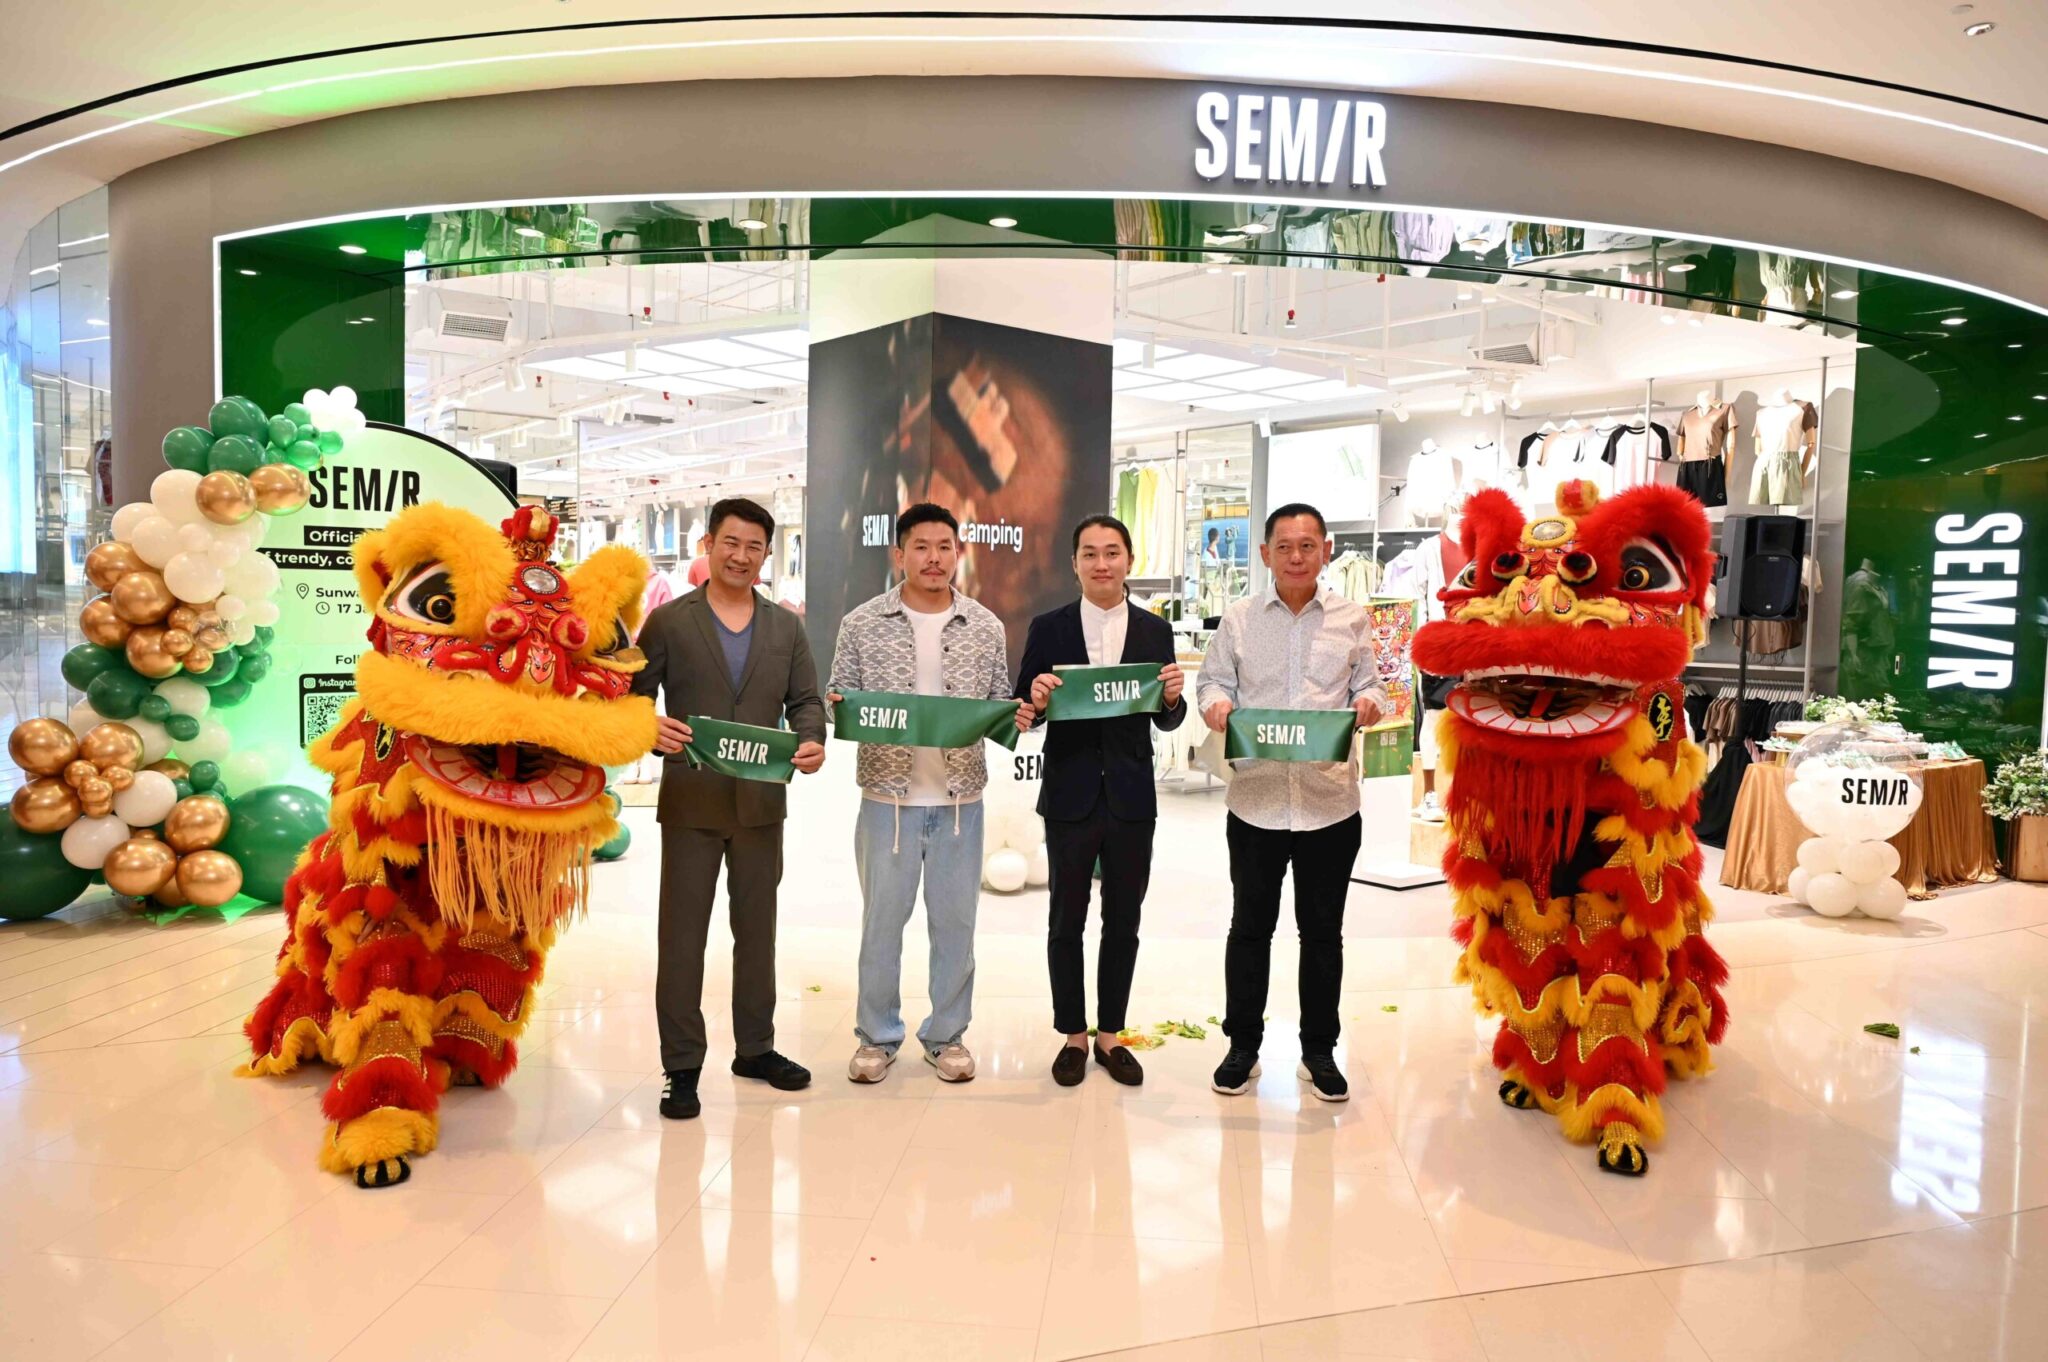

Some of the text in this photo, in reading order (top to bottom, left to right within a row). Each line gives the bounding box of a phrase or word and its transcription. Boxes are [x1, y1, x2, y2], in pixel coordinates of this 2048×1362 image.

[309, 530, 362, 543] Officia
[958, 518, 1023, 552] camping
[274, 552, 332, 567] trendy,
[336, 555, 354, 565] co
[337, 603, 351, 613] 17
